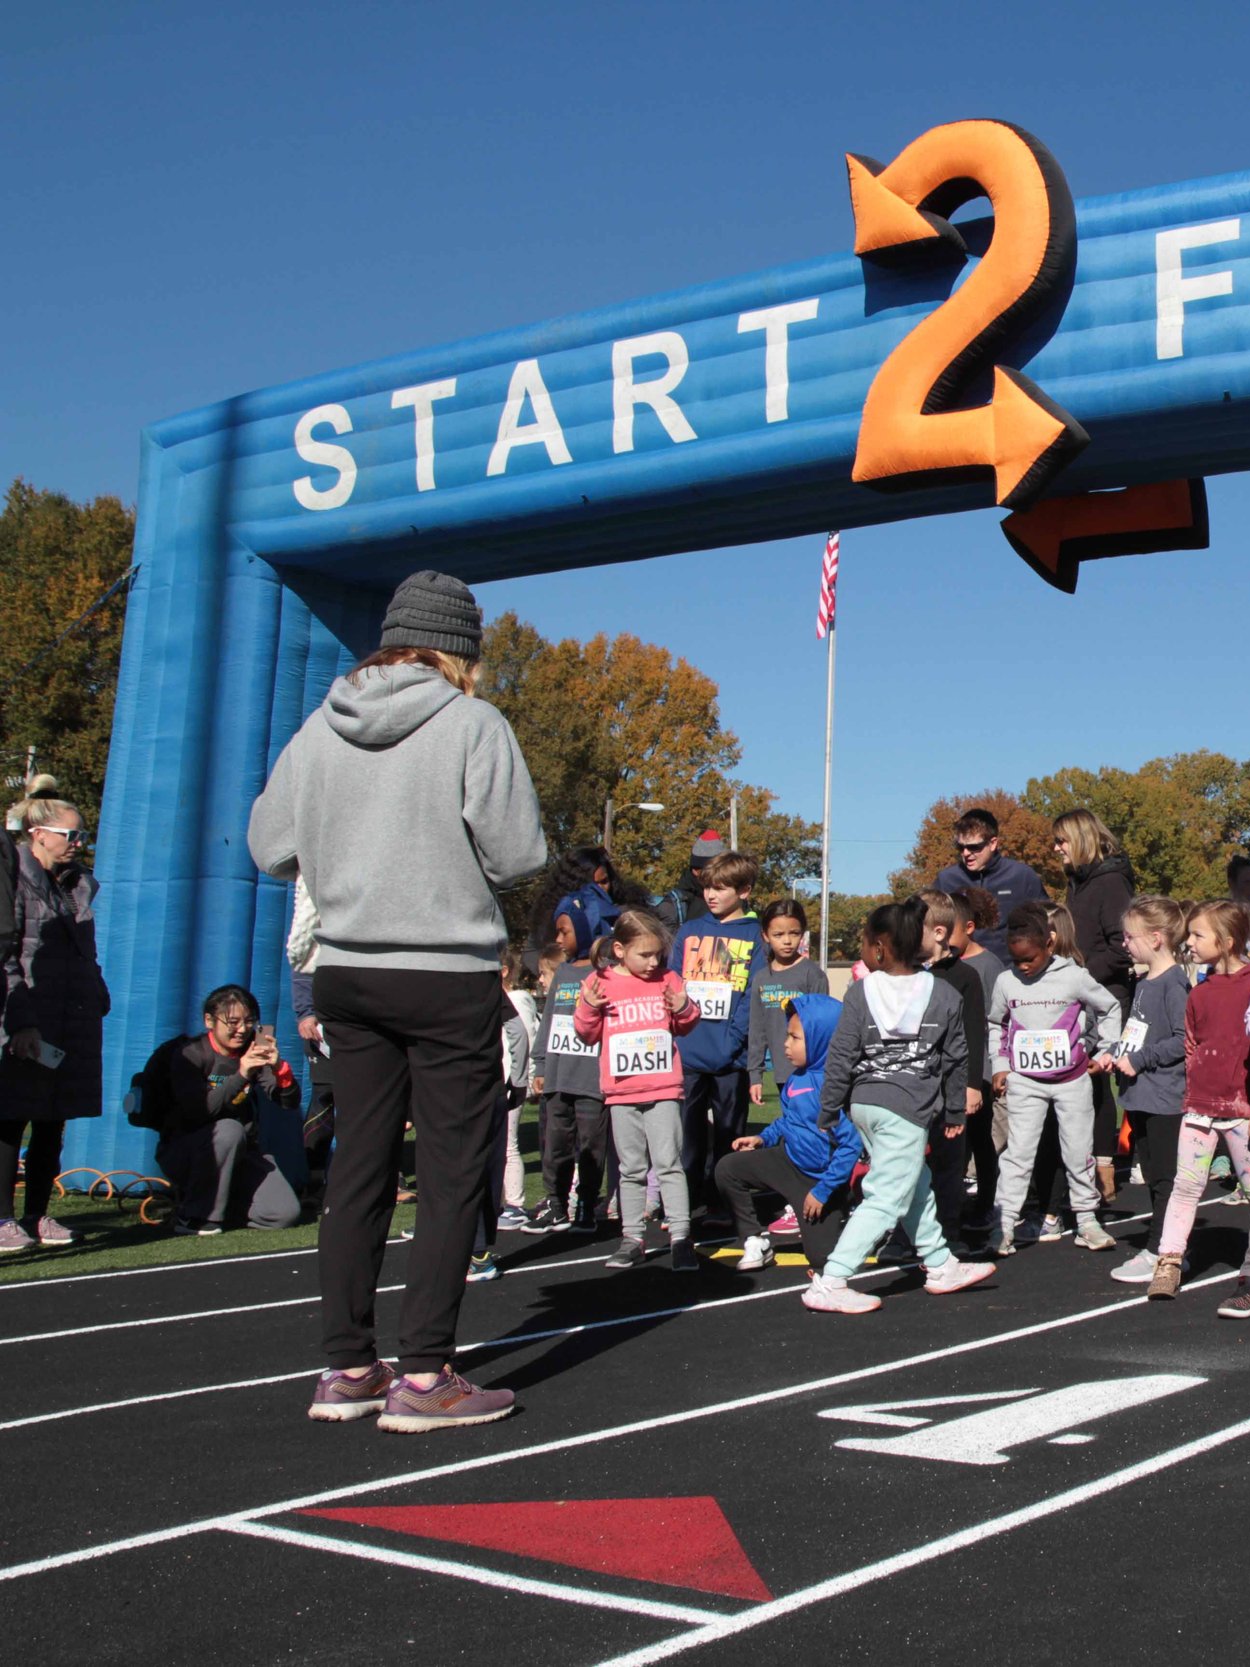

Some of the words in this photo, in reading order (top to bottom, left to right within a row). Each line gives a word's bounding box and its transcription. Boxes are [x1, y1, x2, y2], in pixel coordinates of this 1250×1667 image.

[293, 298, 819, 510] START
[846, 118, 1090, 508] 2
[607, 1001, 666, 1027] LIONS
[616, 1050, 667, 1073] DASH
[1018, 1050, 1066, 1070] DASH
